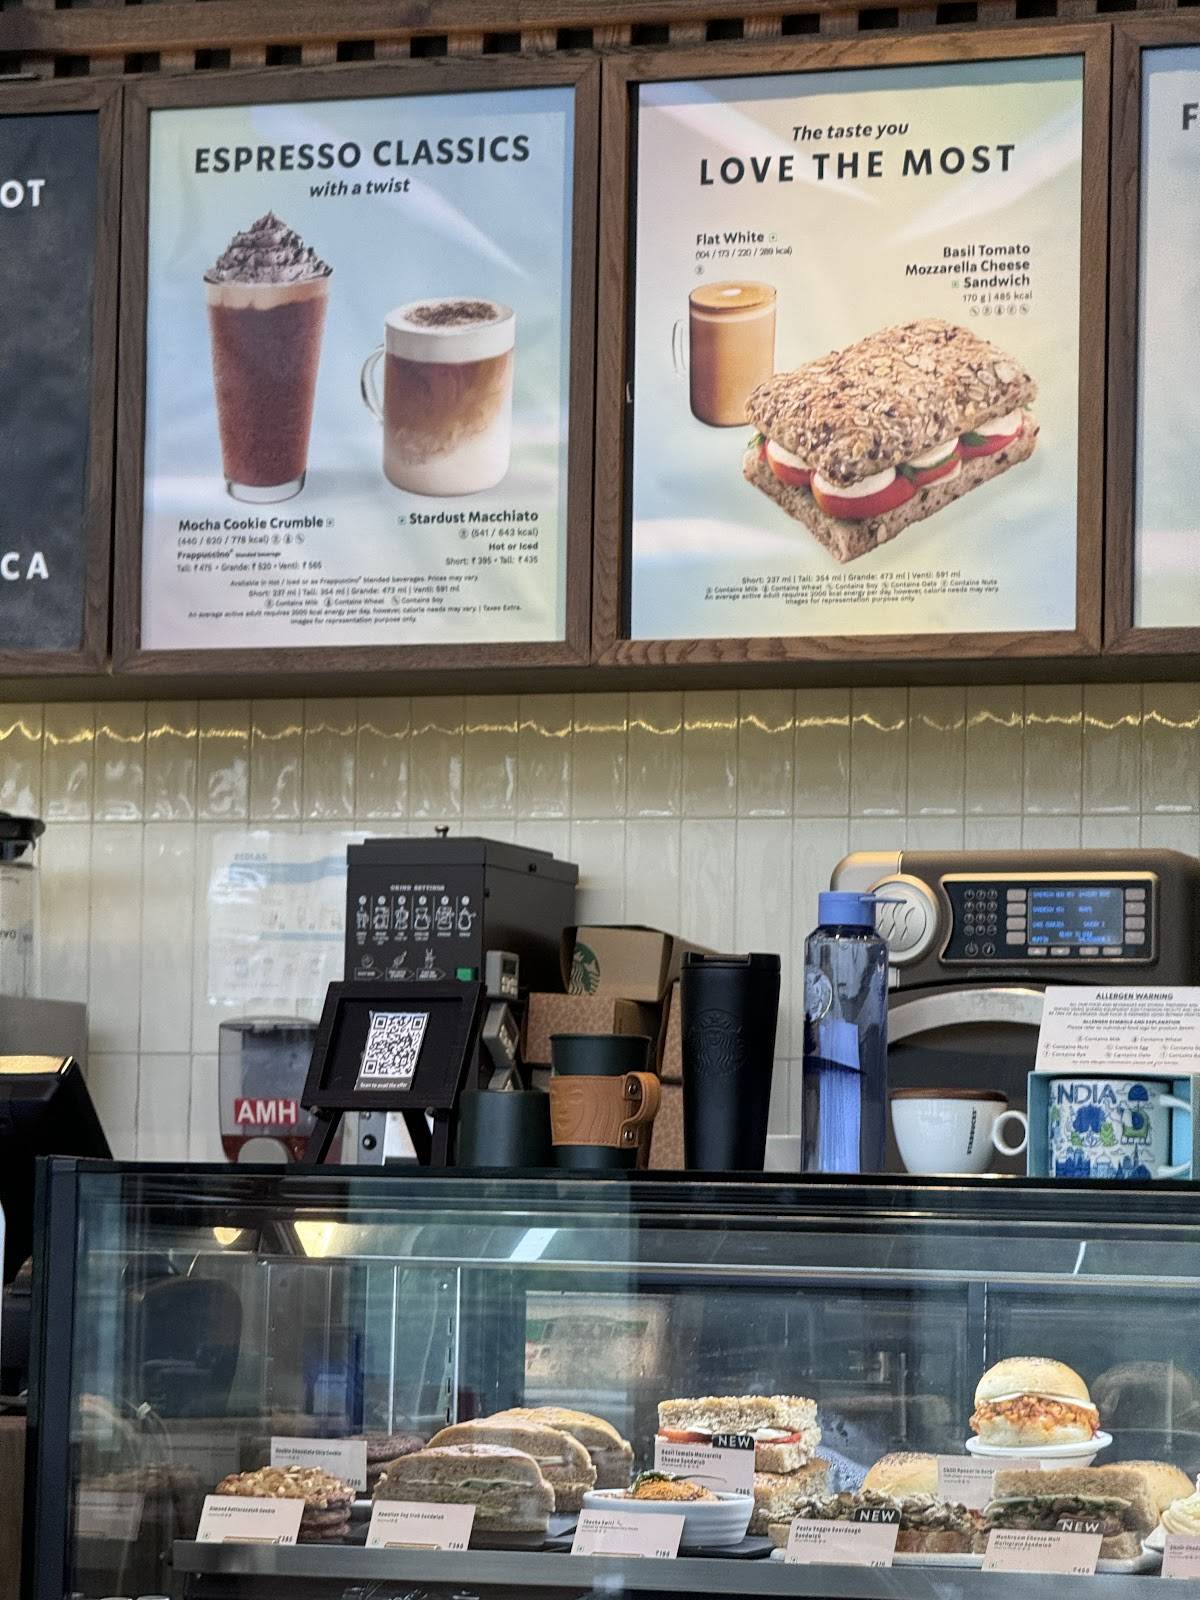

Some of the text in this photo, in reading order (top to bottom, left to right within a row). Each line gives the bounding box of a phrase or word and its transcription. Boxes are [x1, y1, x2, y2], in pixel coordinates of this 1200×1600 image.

[792, 122, 909, 142] The taste you
[195, 135, 530, 173] ESPRESSO CLASSICS
[700, 144, 1016, 186] LOVE THE MOST
[310, 178, 410, 198] with a twist
[696, 231, 765, 245] Flat White
[943, 244, 1030, 258] Basil Tomato
[905, 259, 1030, 276] Mozzarella Cheese
[964, 274, 1030, 288] Sandwich
[963, 294, 977, 302] 170
[1013, 291, 1033, 300] kcal
[179, 515, 324, 532] Mocha Cookie Crumble
[410, 510, 539, 525] Stardust Macchiato
[248, 533, 269, 544] kcal)
[517, 527, 539, 538] kcal)
[488, 543, 505, 551] Hot
[519, 542, 539, 550] Iced
[1096, 992, 1173, 1001] ALLERGEN WARNING
[237, 1100, 296, 1124] AMH
[718, 1435, 750, 1449] NEW
[860, 1510, 895, 1522] NEW
[1061, 1520, 1099, 1532] NEW
